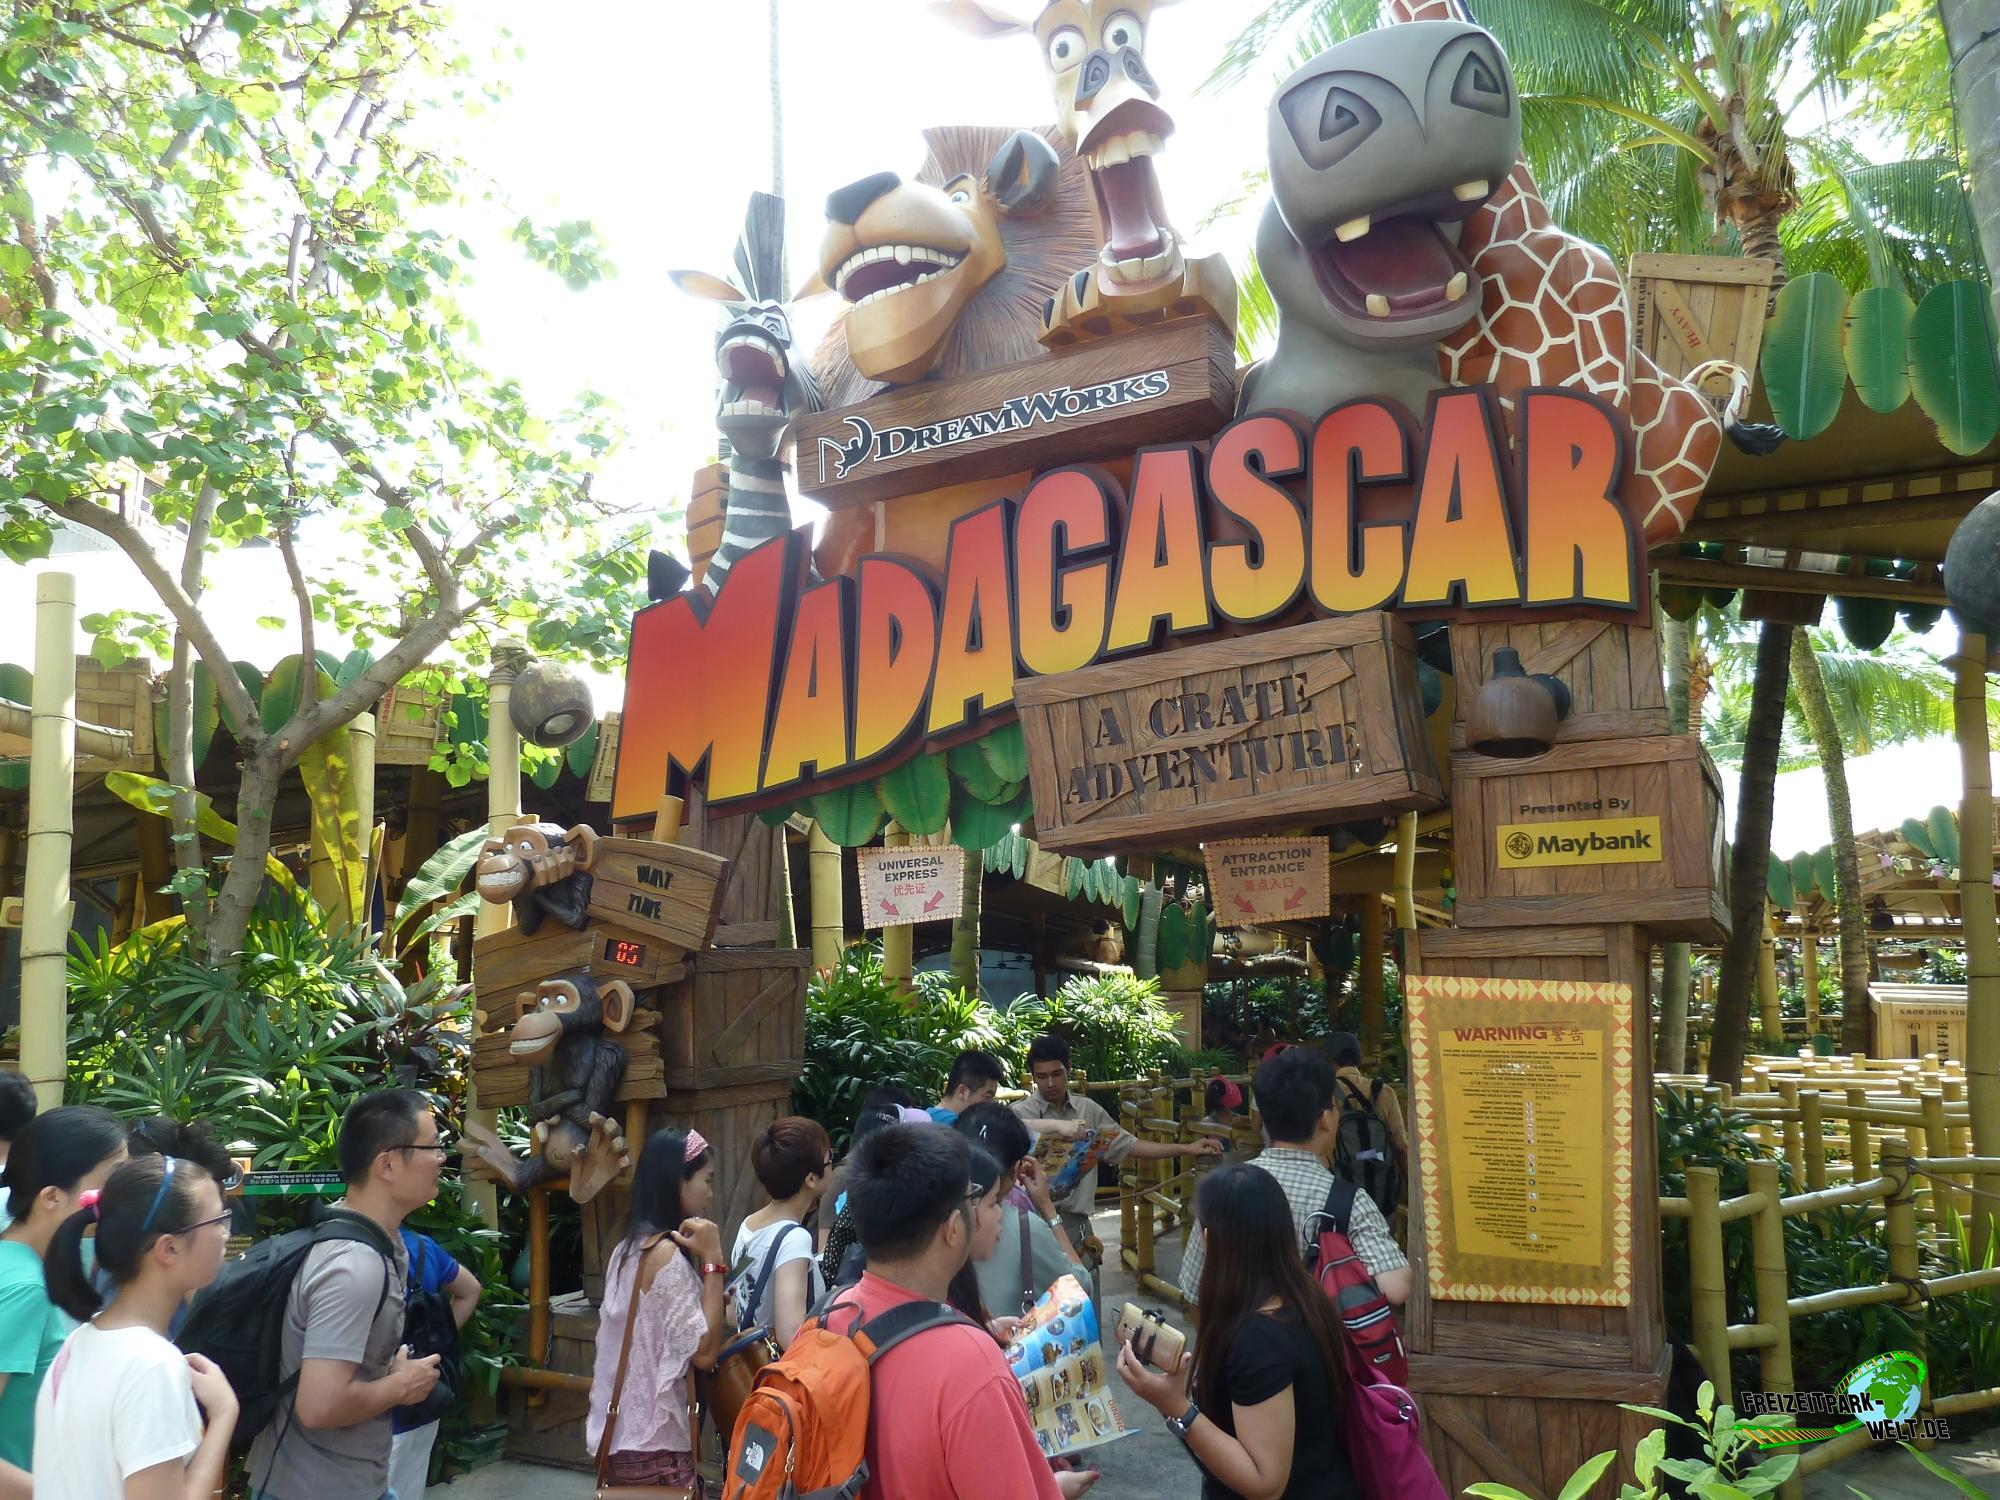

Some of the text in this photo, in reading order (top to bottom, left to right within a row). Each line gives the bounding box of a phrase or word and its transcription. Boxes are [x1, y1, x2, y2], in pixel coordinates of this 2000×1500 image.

[1669, 307, 1702, 348] HEAVY
[612, 387, 1635, 825] MADAGASCAR
[1095, 672, 1312, 748] A CRATE
[1064, 721, 1362, 804] ADVENTURE
[1520, 797, 1630, 815] Presented By
[1537, 830, 1652, 856] Maybank
[879, 856, 944, 871] UNIVERSAL
[1222, 848, 1312, 865] ATTRACTION
[1231, 862, 1305, 877] ENTRANCE
[893, 882, 926, 896] 优先证
[1245, 877, 1294, 892] 景点入口
[1453, 1025, 1547, 1042] WARNING
[1550, 1025, 1584, 1042] 警告
